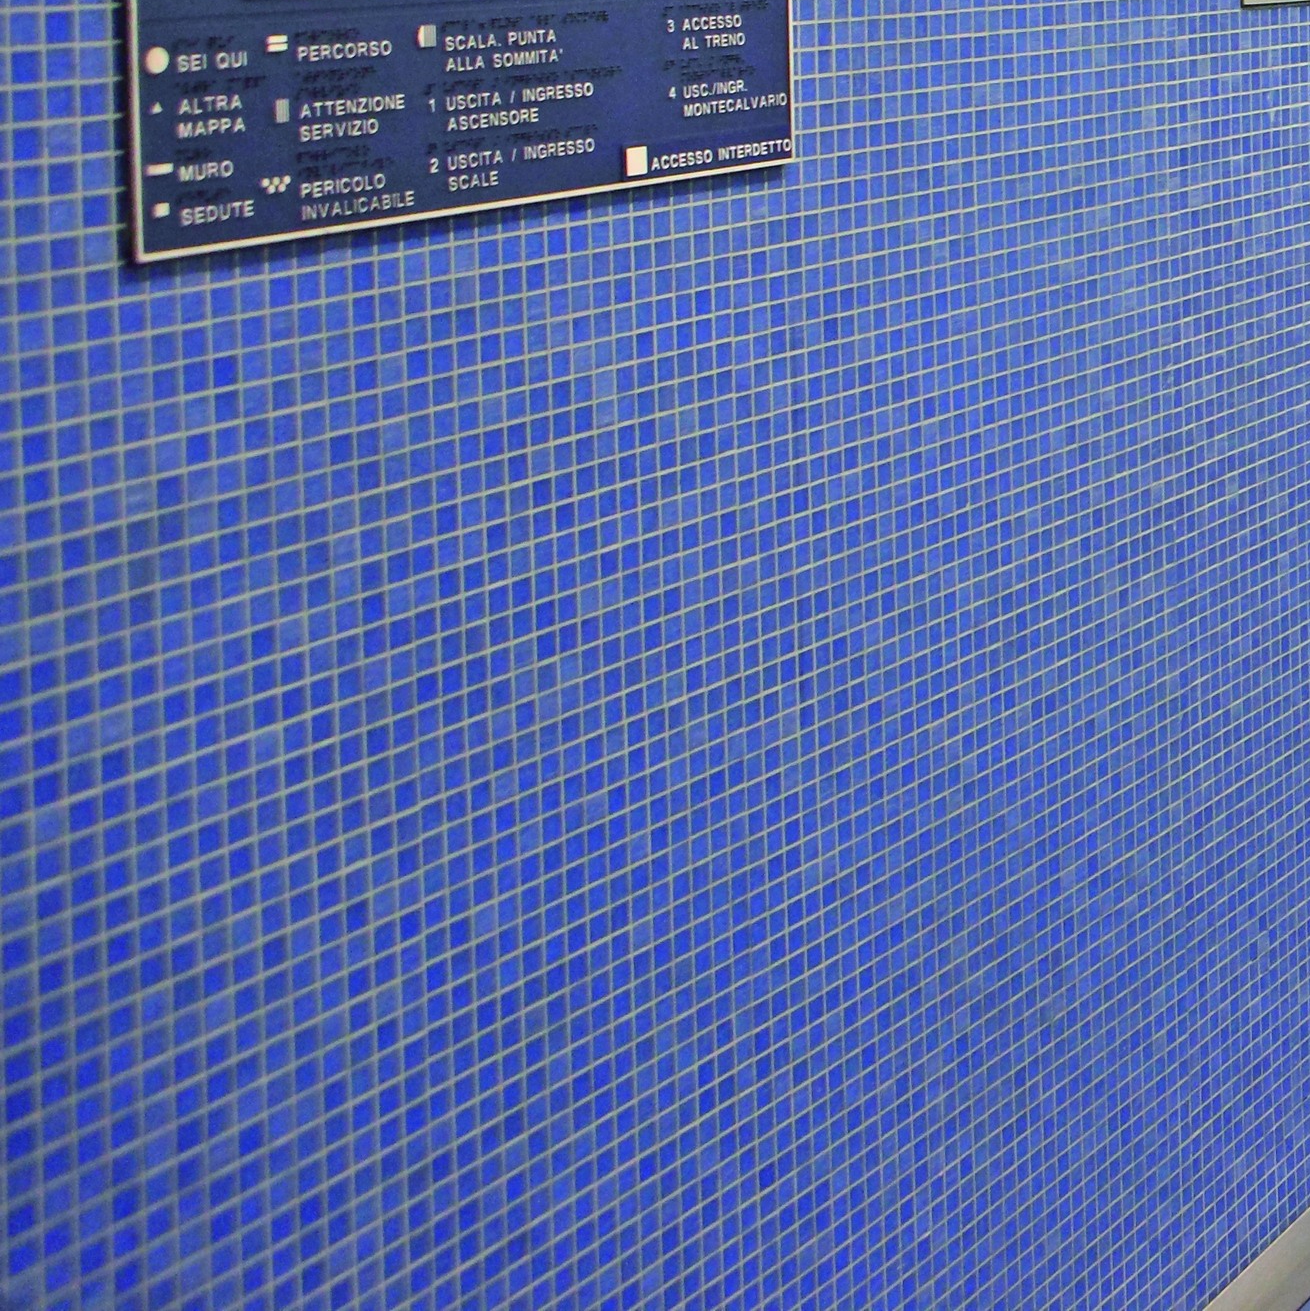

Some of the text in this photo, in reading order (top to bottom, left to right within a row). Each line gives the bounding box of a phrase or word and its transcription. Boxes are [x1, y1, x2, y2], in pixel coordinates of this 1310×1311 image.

[667, 14, 742, 32] 3 ACCESSO
[509, 30, 556, 45] PUNTA
[683, 33, 745, 50] AL TRENO
[298, 40, 392, 61] PERCORSO
[446, 50, 563, 72] ALLA SOMMITA'
[177, 51, 247, 73] SEI QUI
[428, 99, 435, 112] 1
[446, 92, 502, 111] USCITA
[522, 83, 594, 102] INGRESSO
[668, 87, 676, 100] 4
[178, 95, 242, 115] ALTRA
[299, 94, 405, 119] ATTENZIONE
[683, 92, 788, 118] MONTECALVARIO
[177, 120, 246, 139] MAPPA
[299, 119, 379, 142] SERVIZIO
[447, 108, 539, 132] ASCENSORE
[429, 158, 439, 174] 2
[448, 149, 503, 170] USCITA
[524, 139, 595, 159] INGRESSO
[651, 139, 792, 170] ACCESSO INTERDETTO
[178, 161, 234, 181] MURO
[448, 172, 499, 191] SCALE
[300, 174, 385, 198] PERICOLO
[181, 201, 255, 226] SEDUTE
[301, 191, 415, 221] INVALICABILE
